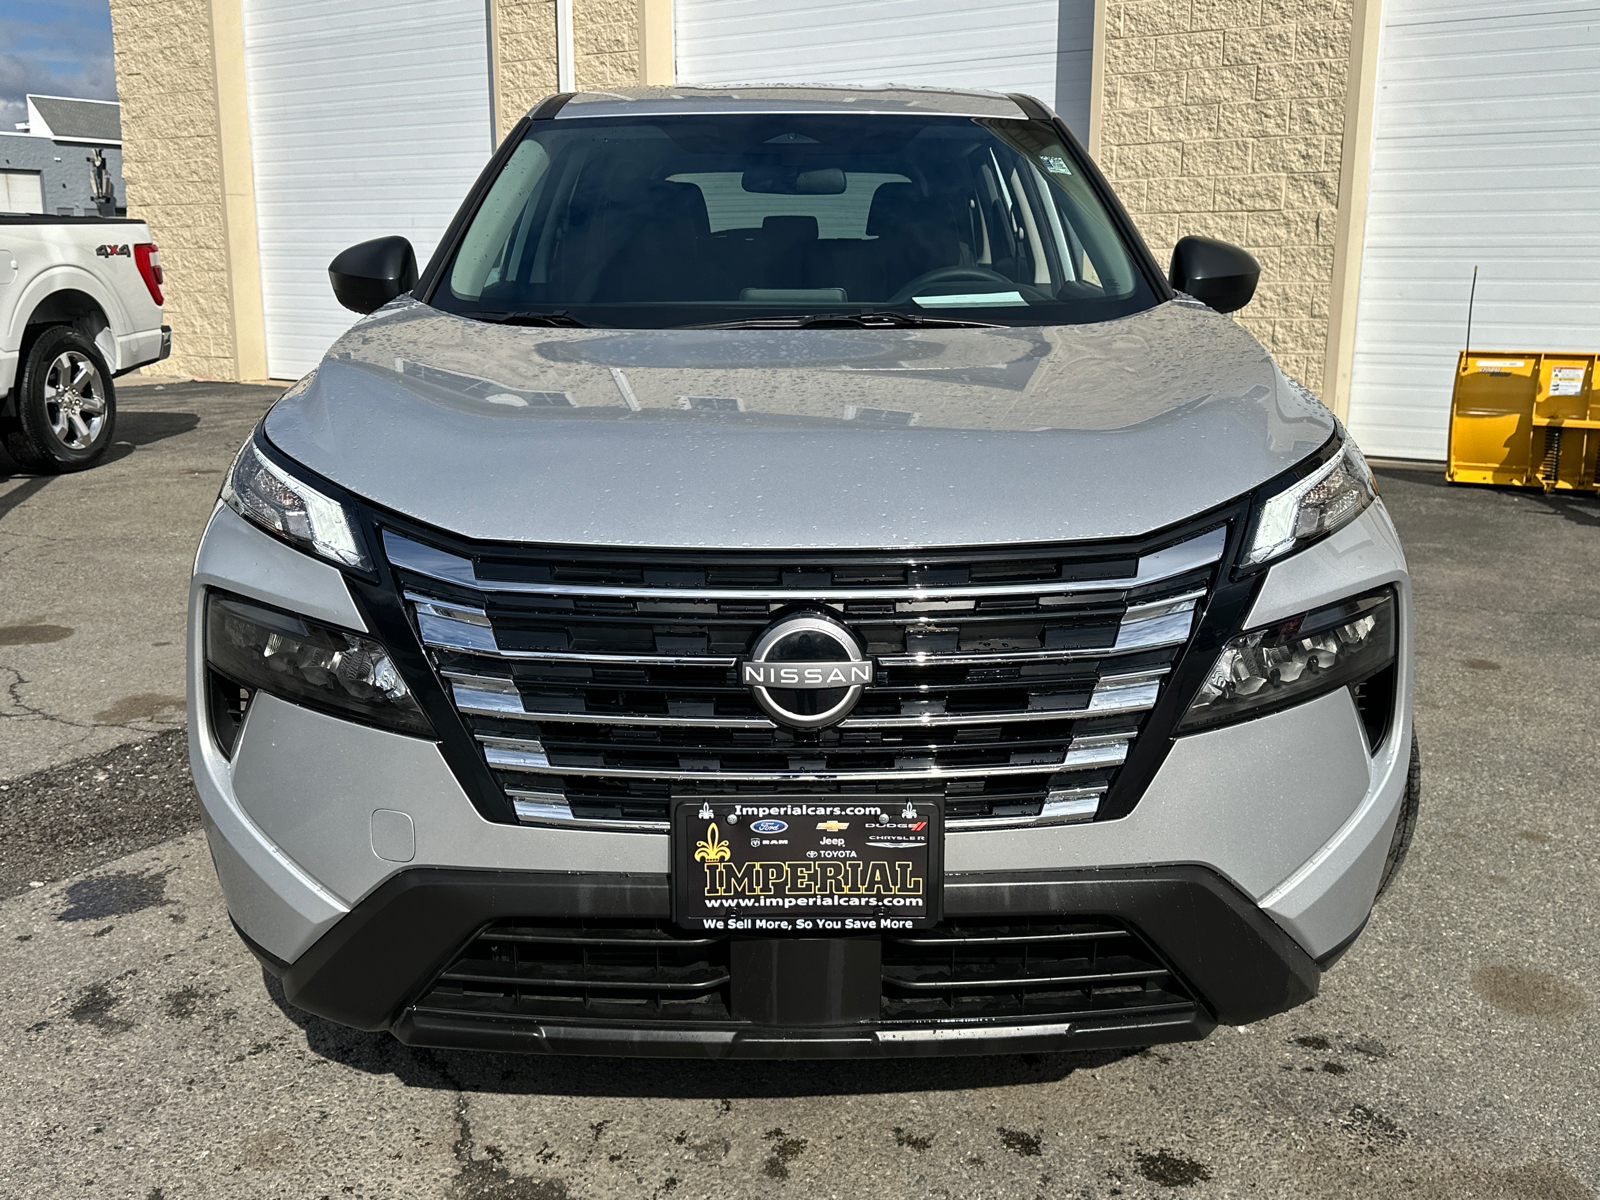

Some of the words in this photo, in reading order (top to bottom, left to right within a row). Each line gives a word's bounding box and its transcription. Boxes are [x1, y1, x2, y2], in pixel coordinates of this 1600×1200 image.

[745, 665, 870, 684] NISSAN
[734, 804, 882, 818] Imperialcars.com
[819, 836, 844, 847] Jeep
[819, 850, 858, 859] TOYOTA
[704, 860, 923, 897] IMPERIAL
[704, 895, 923, 909] www.imperialcars.com
[703, 918, 726, 930] We
[727, 918, 752, 930] Sell
[756, 918, 793, 931] More,
[795, 918, 813, 930] So
[815, 918, 842, 930] You
[844, 918, 877, 930] Save
[880, 918, 913, 930] More
